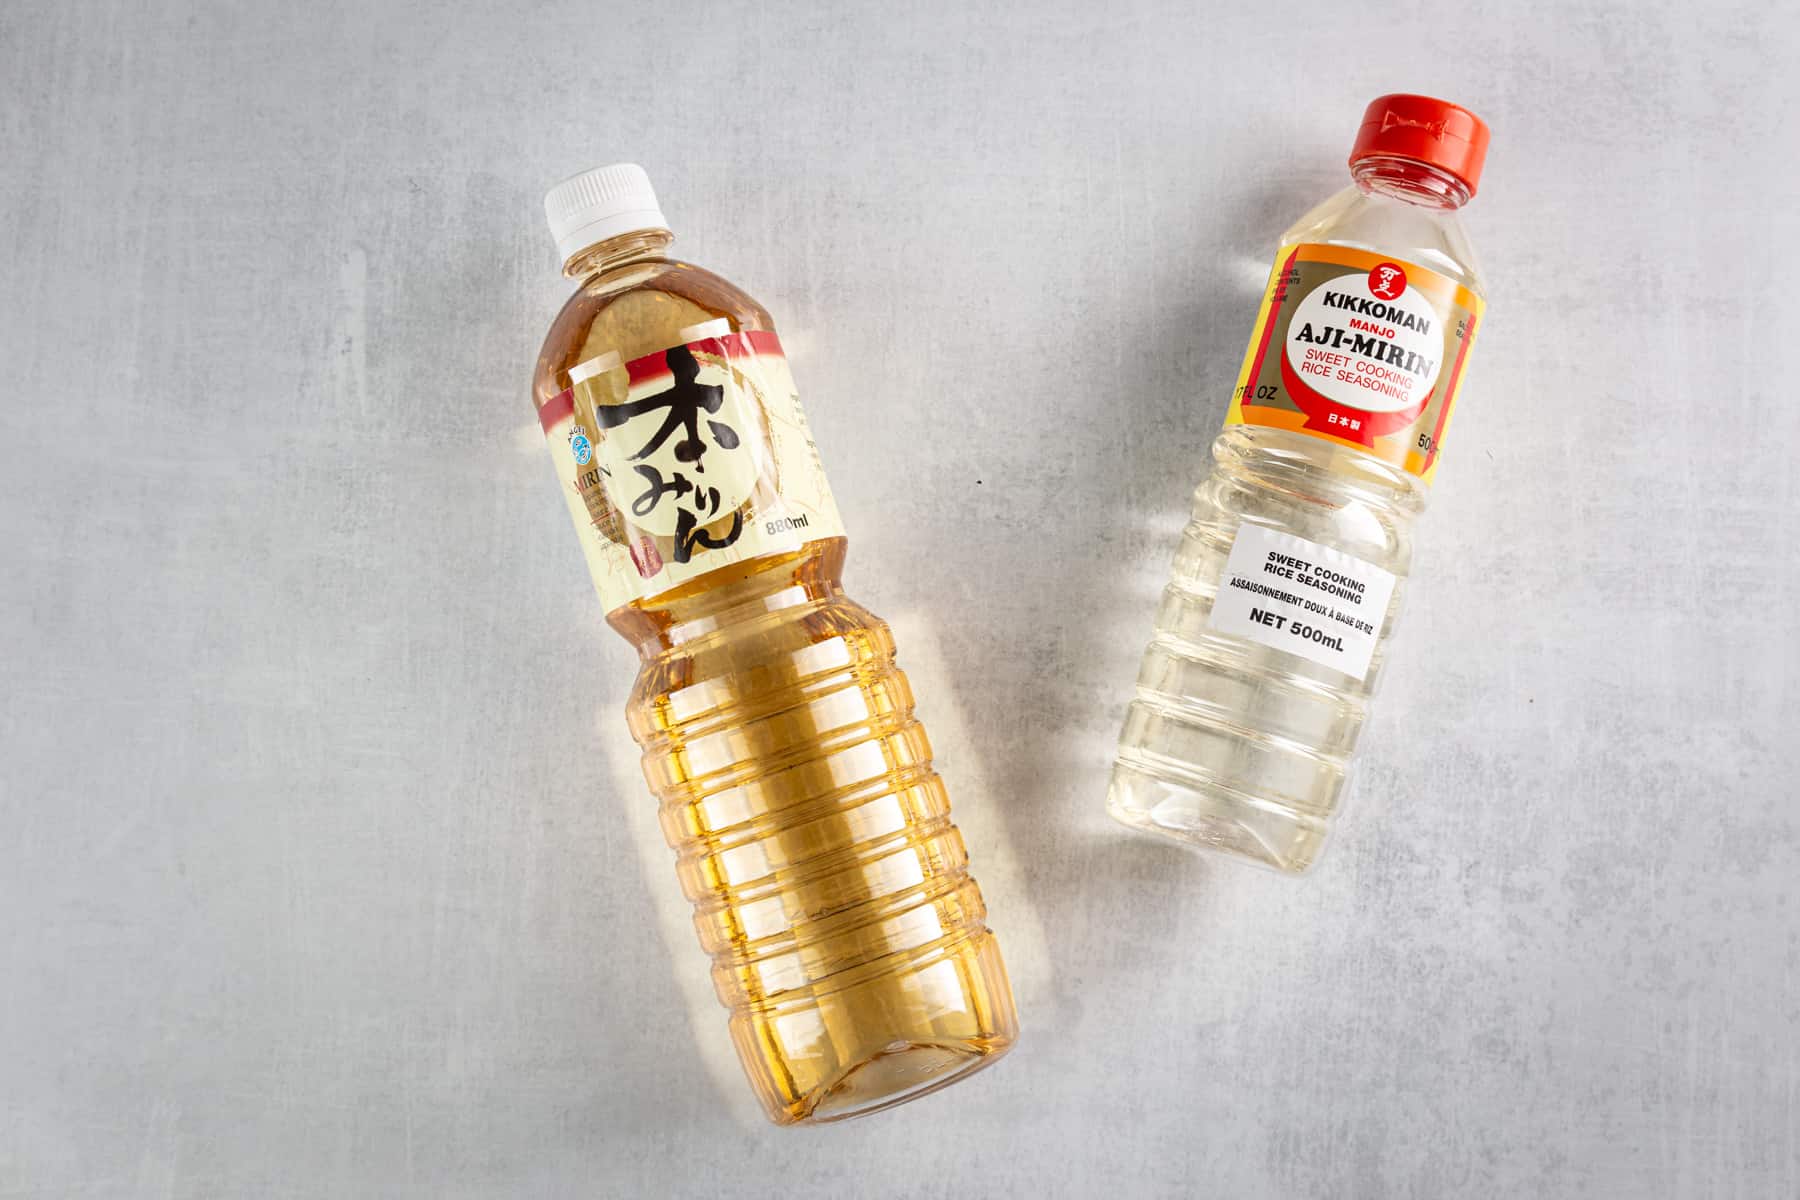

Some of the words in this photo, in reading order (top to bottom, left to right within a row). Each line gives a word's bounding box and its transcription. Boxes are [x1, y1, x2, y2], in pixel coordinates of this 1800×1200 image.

[1322, 291, 1431, 336] KIKKOMAN
[1349, 318, 1396, 339] MANJO
[1295, 322, 1434, 380] AJI-MIRIN
[1305, 348, 1352, 368] SWEET
[1355, 360, 1414, 390] COOKING
[1257, 384, 1279, 401] OZ
[1301, 361, 1332, 378] RICE
[1336, 370, 1409, 401] SEASONING
[1327, 413, 1361, 430] 日本製
[596, 344, 744, 564] 本みりん
[765, 513, 810, 536] 880ml
[1263, 562, 1294, 580] RICE
[1296, 573, 1362, 605] SEASONING
[1267, 551, 1312, 573] SWEET
[1314, 566, 1366, 594] COOKING
[1230, 577, 1304, 607] ASSAISONNEMENT
[1304, 599, 1327, 617] DOUX
[1328, 606, 1335, 619] À
[1335, 611, 1355, 627] BASE
[1249, 607, 1288, 630] NET
[1290, 624, 1344, 652] 500mL
